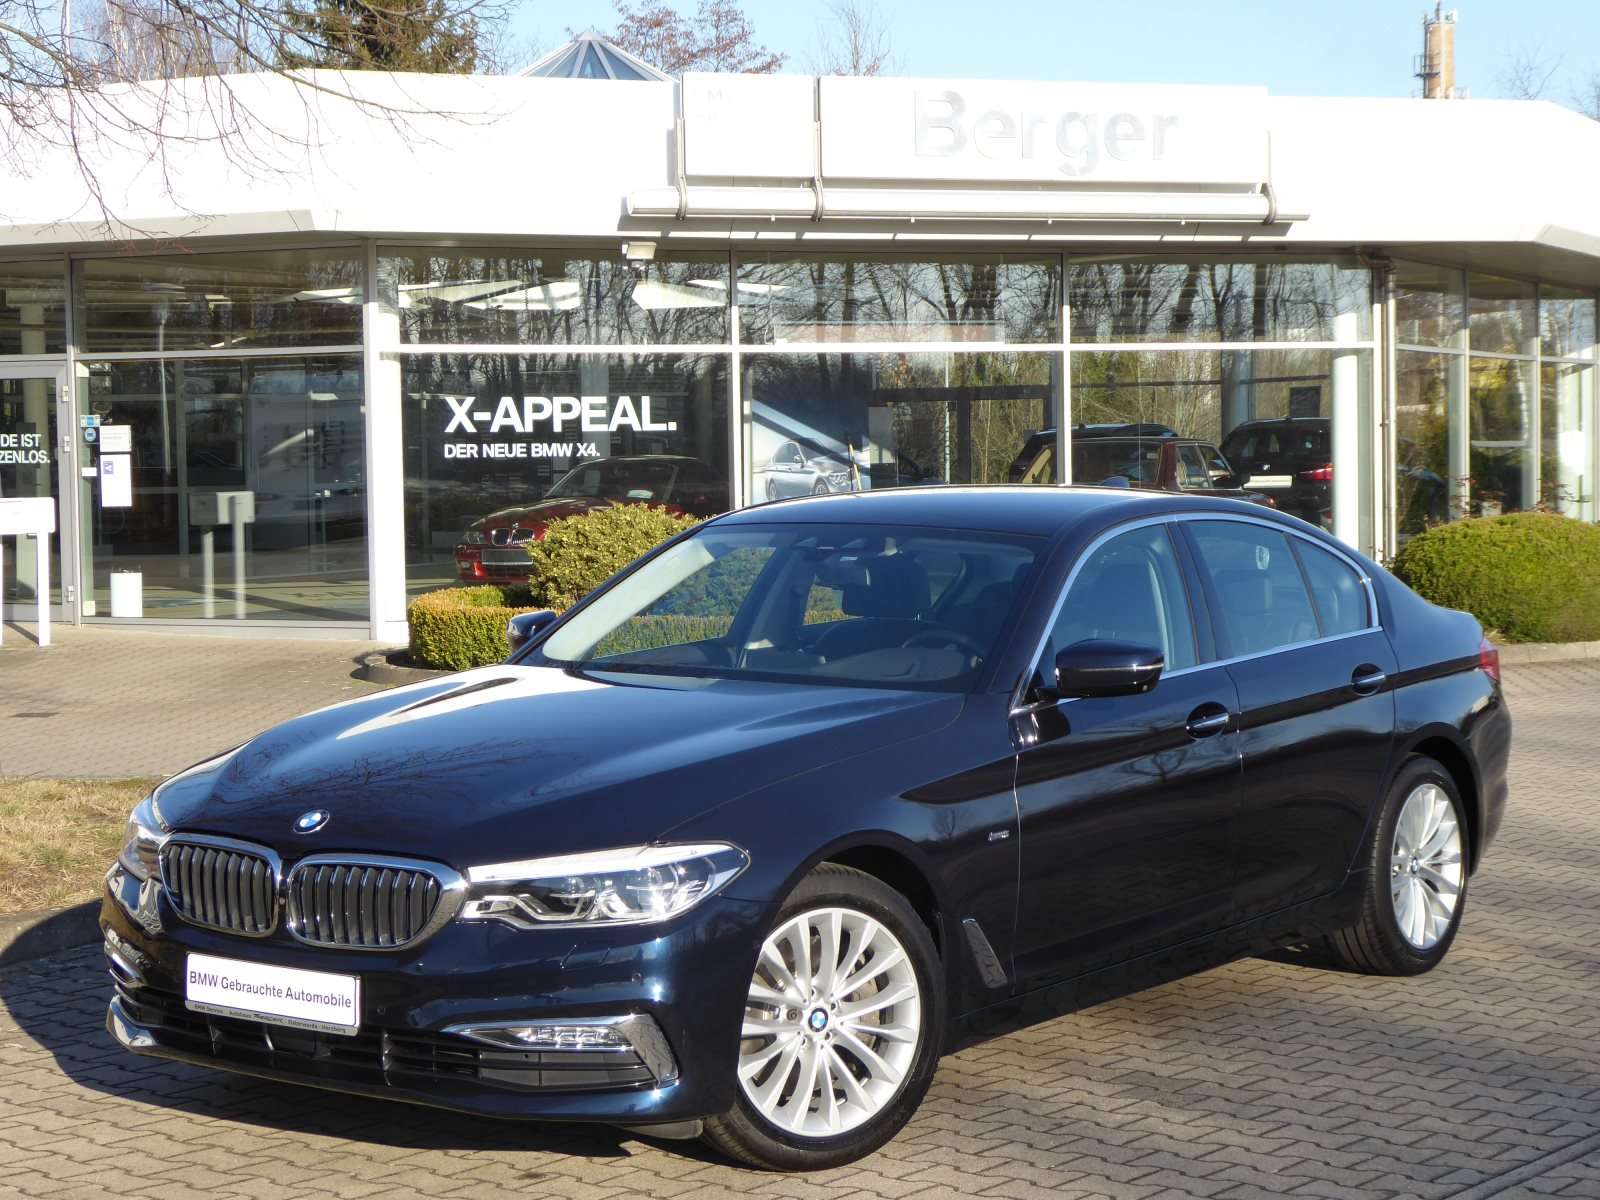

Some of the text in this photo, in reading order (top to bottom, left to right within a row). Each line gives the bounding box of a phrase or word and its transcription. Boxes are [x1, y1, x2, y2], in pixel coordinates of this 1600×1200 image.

[914, 91, 1178, 176] Berger
[444, 396, 677, 432] X-APPEAL.
[21, 433, 42, 447] IST
[444, 442, 600, 459] DER NEUE BMW X4.
[189, 970, 352, 1009] BMW Gebrauchte Automobile
